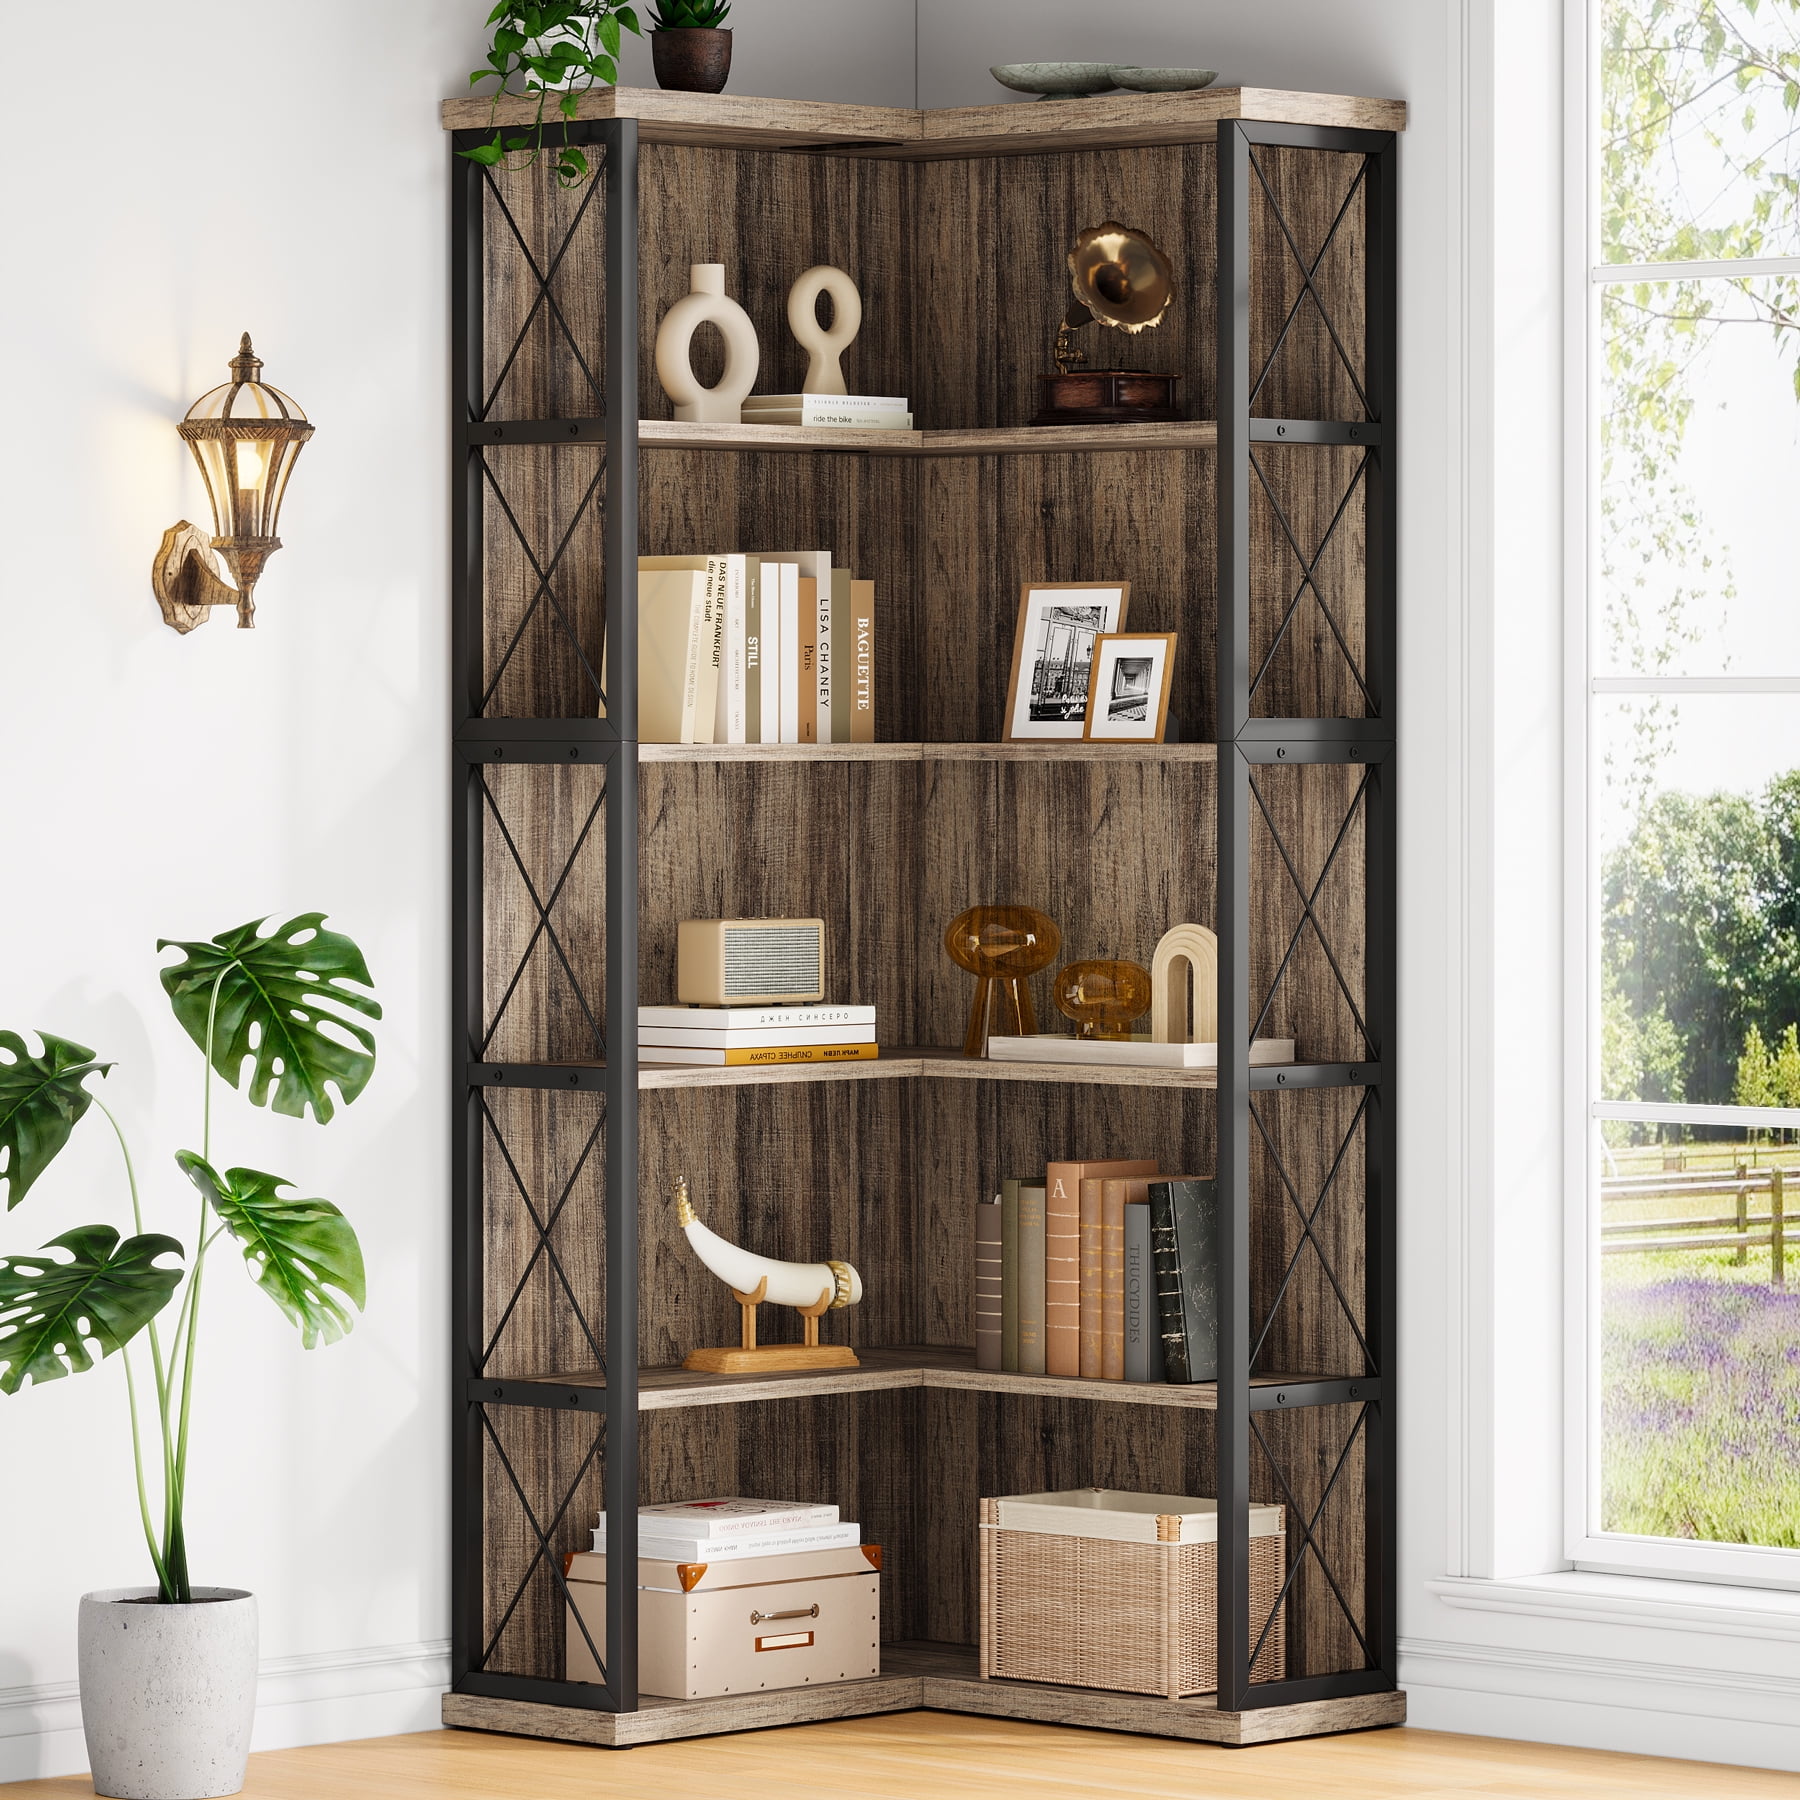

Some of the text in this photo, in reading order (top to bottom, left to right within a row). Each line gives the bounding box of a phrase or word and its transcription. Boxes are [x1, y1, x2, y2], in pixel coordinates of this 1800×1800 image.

[839, 416, 852, 424] bike
[708, 560, 716, 574] die
[704, 599, 712, 622] stadt
[712, 562, 727, 669] DAS NEUE FRANKFURT
[747, 636, 759, 669] STILL
[804, 645, 815, 670] Paris
[820, 599, 830, 708] LISA CHANEY
[857, 617, 870, 710] BAGUETTE
[760, 1012, 849, 1023] ДЖЕН СИНСЕРО
[1051, 1178, 1068, 1199] A
[1129, 1244, 1140, 1344] THUCYDIDES
